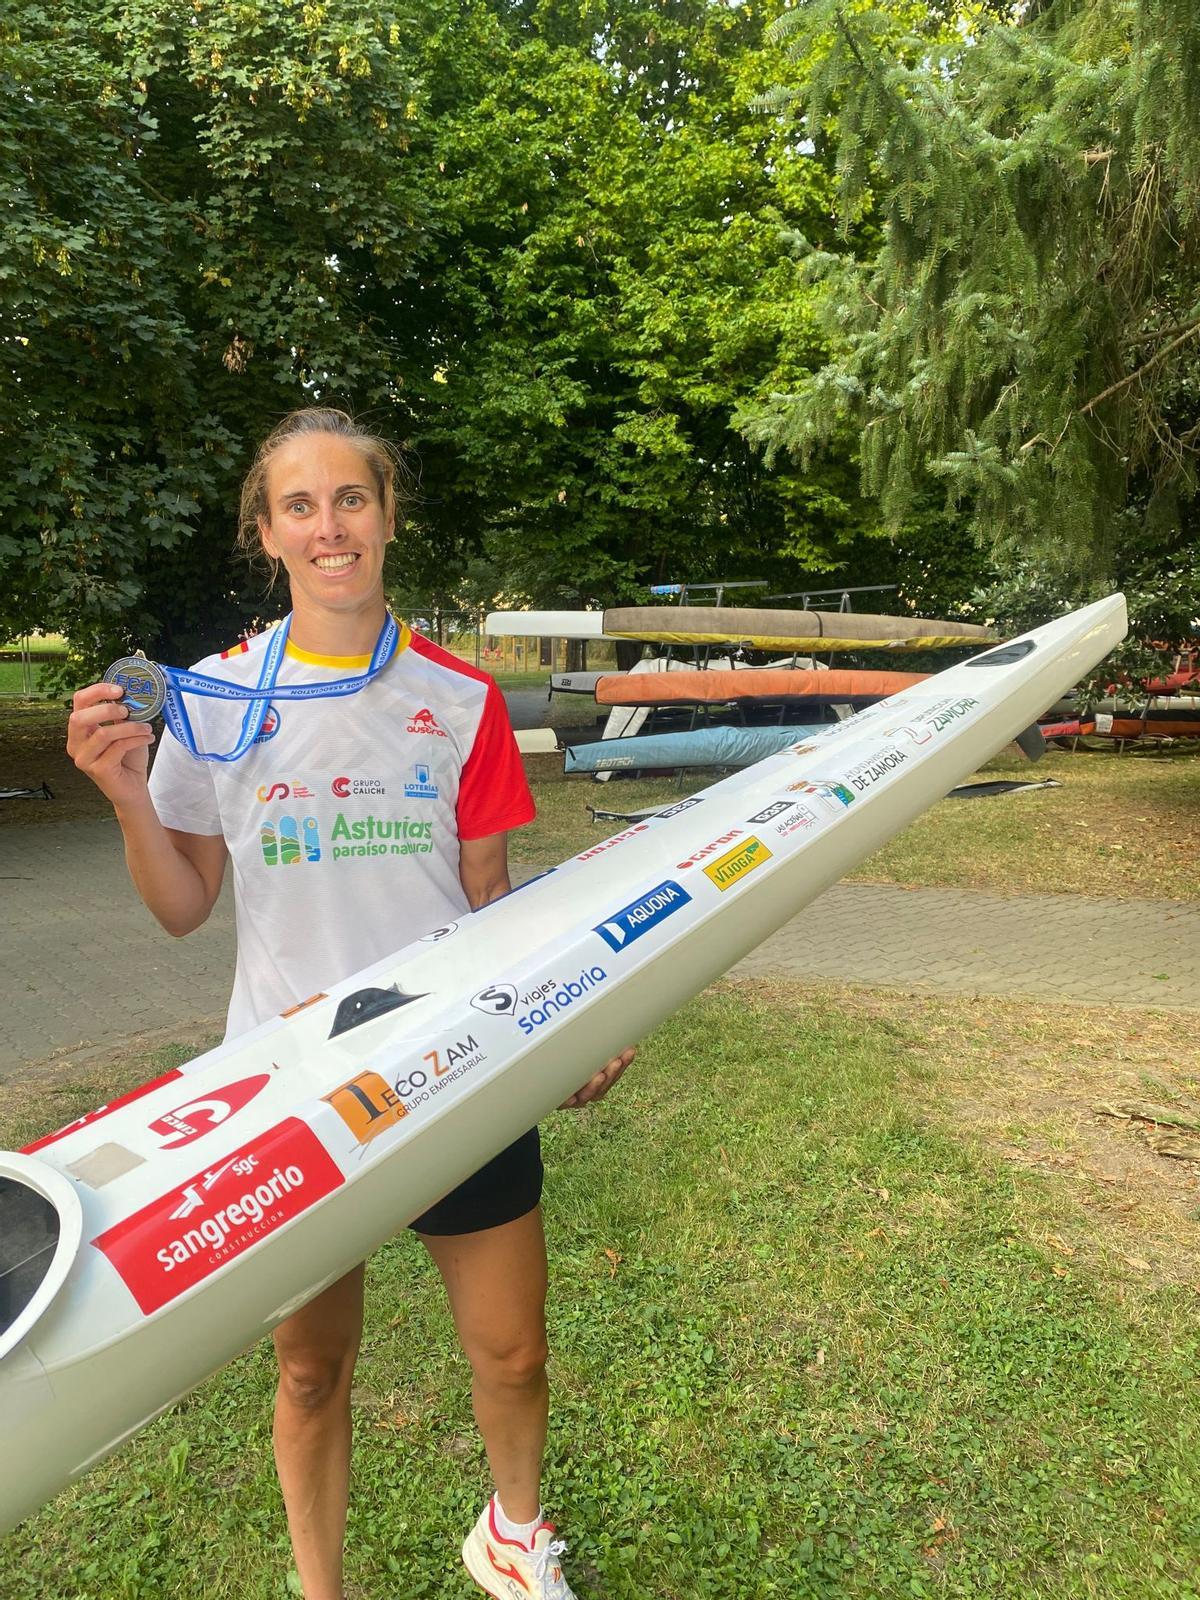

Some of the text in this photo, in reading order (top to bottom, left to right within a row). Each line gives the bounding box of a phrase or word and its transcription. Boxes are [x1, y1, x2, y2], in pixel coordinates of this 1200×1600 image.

[114, 673, 153, 696] ECA
[195, 680, 226, 693] CANOE
[927, 697, 980, 732] ZAMORA
[851, 750, 909, 791] DE ZAMORA
[352, 787, 386, 795] CALICHE
[332, 842, 434, 861] paraíso natural
[714, 854, 756, 883] VIJOGA
[626, 887, 681, 928] AQUONA
[518, 966, 607, 1035] sanabria
[520, 979, 557, 1006] viajes
[423, 1034, 480, 1077] ZAM
[396, 1053, 488, 1119] GRUPO EMPRESARIAL
[159, 1114, 198, 1136] CINCO
[231, 1153, 259, 1176] sgc
[156, 1164, 305, 1273] sangregorio
